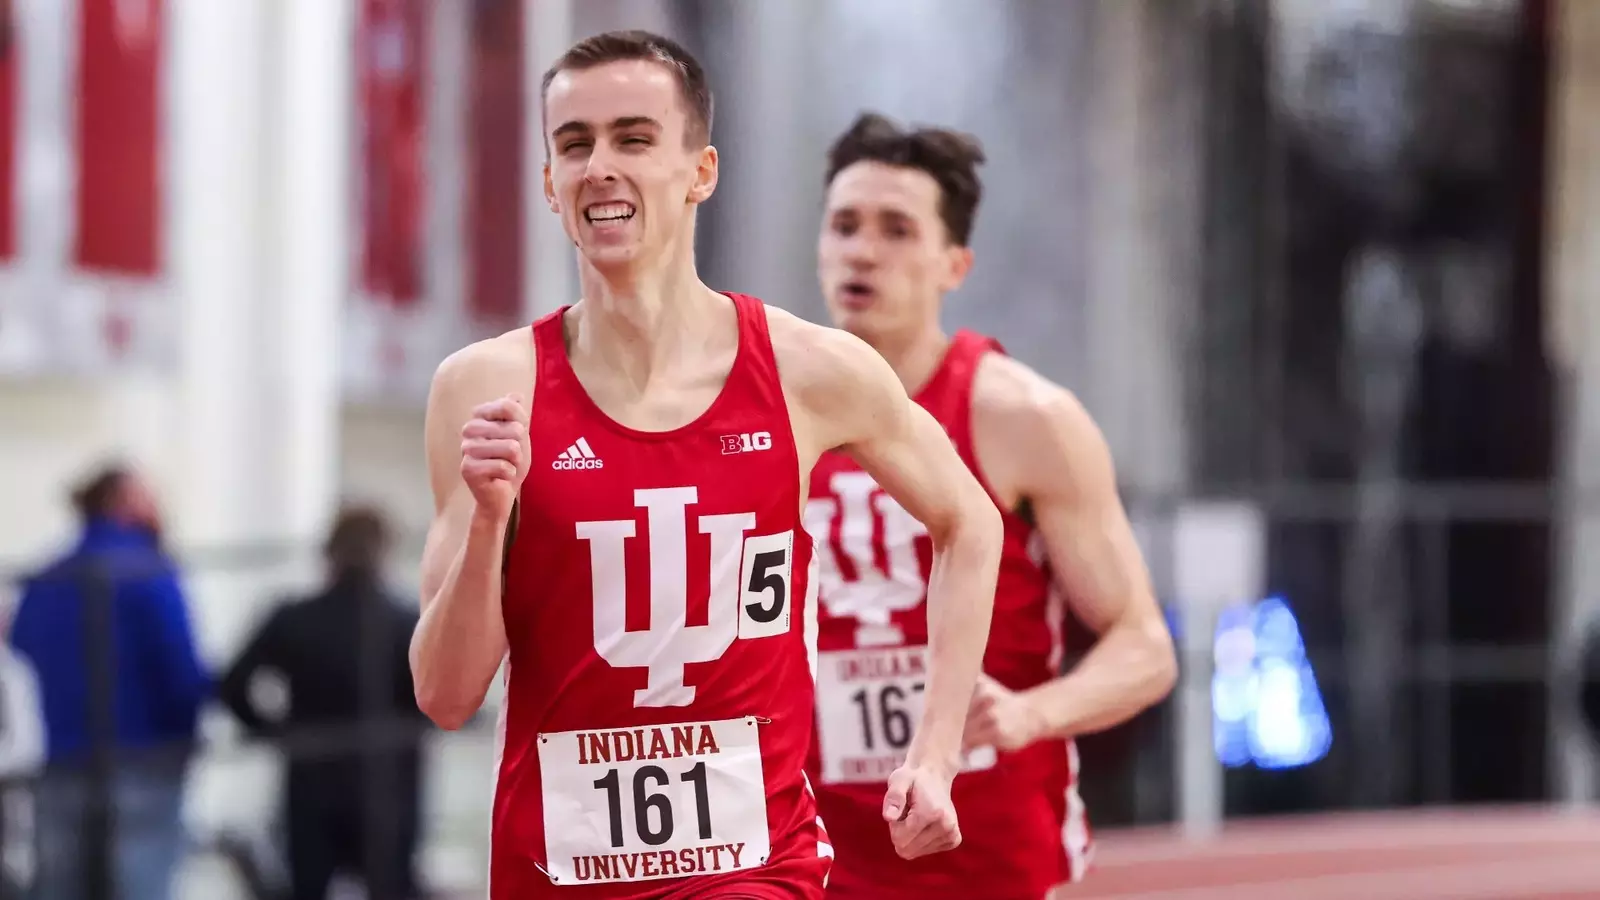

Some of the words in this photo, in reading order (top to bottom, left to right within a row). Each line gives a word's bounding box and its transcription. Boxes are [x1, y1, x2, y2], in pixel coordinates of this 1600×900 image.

[552, 458, 603, 470] adidas
[745, 549, 786, 623] 5
[852, 684, 925, 750] 16
[577, 725, 719, 764] INDIANA
[593, 762, 712, 848] 161
[573, 842, 745, 881] UNIVERSITY
